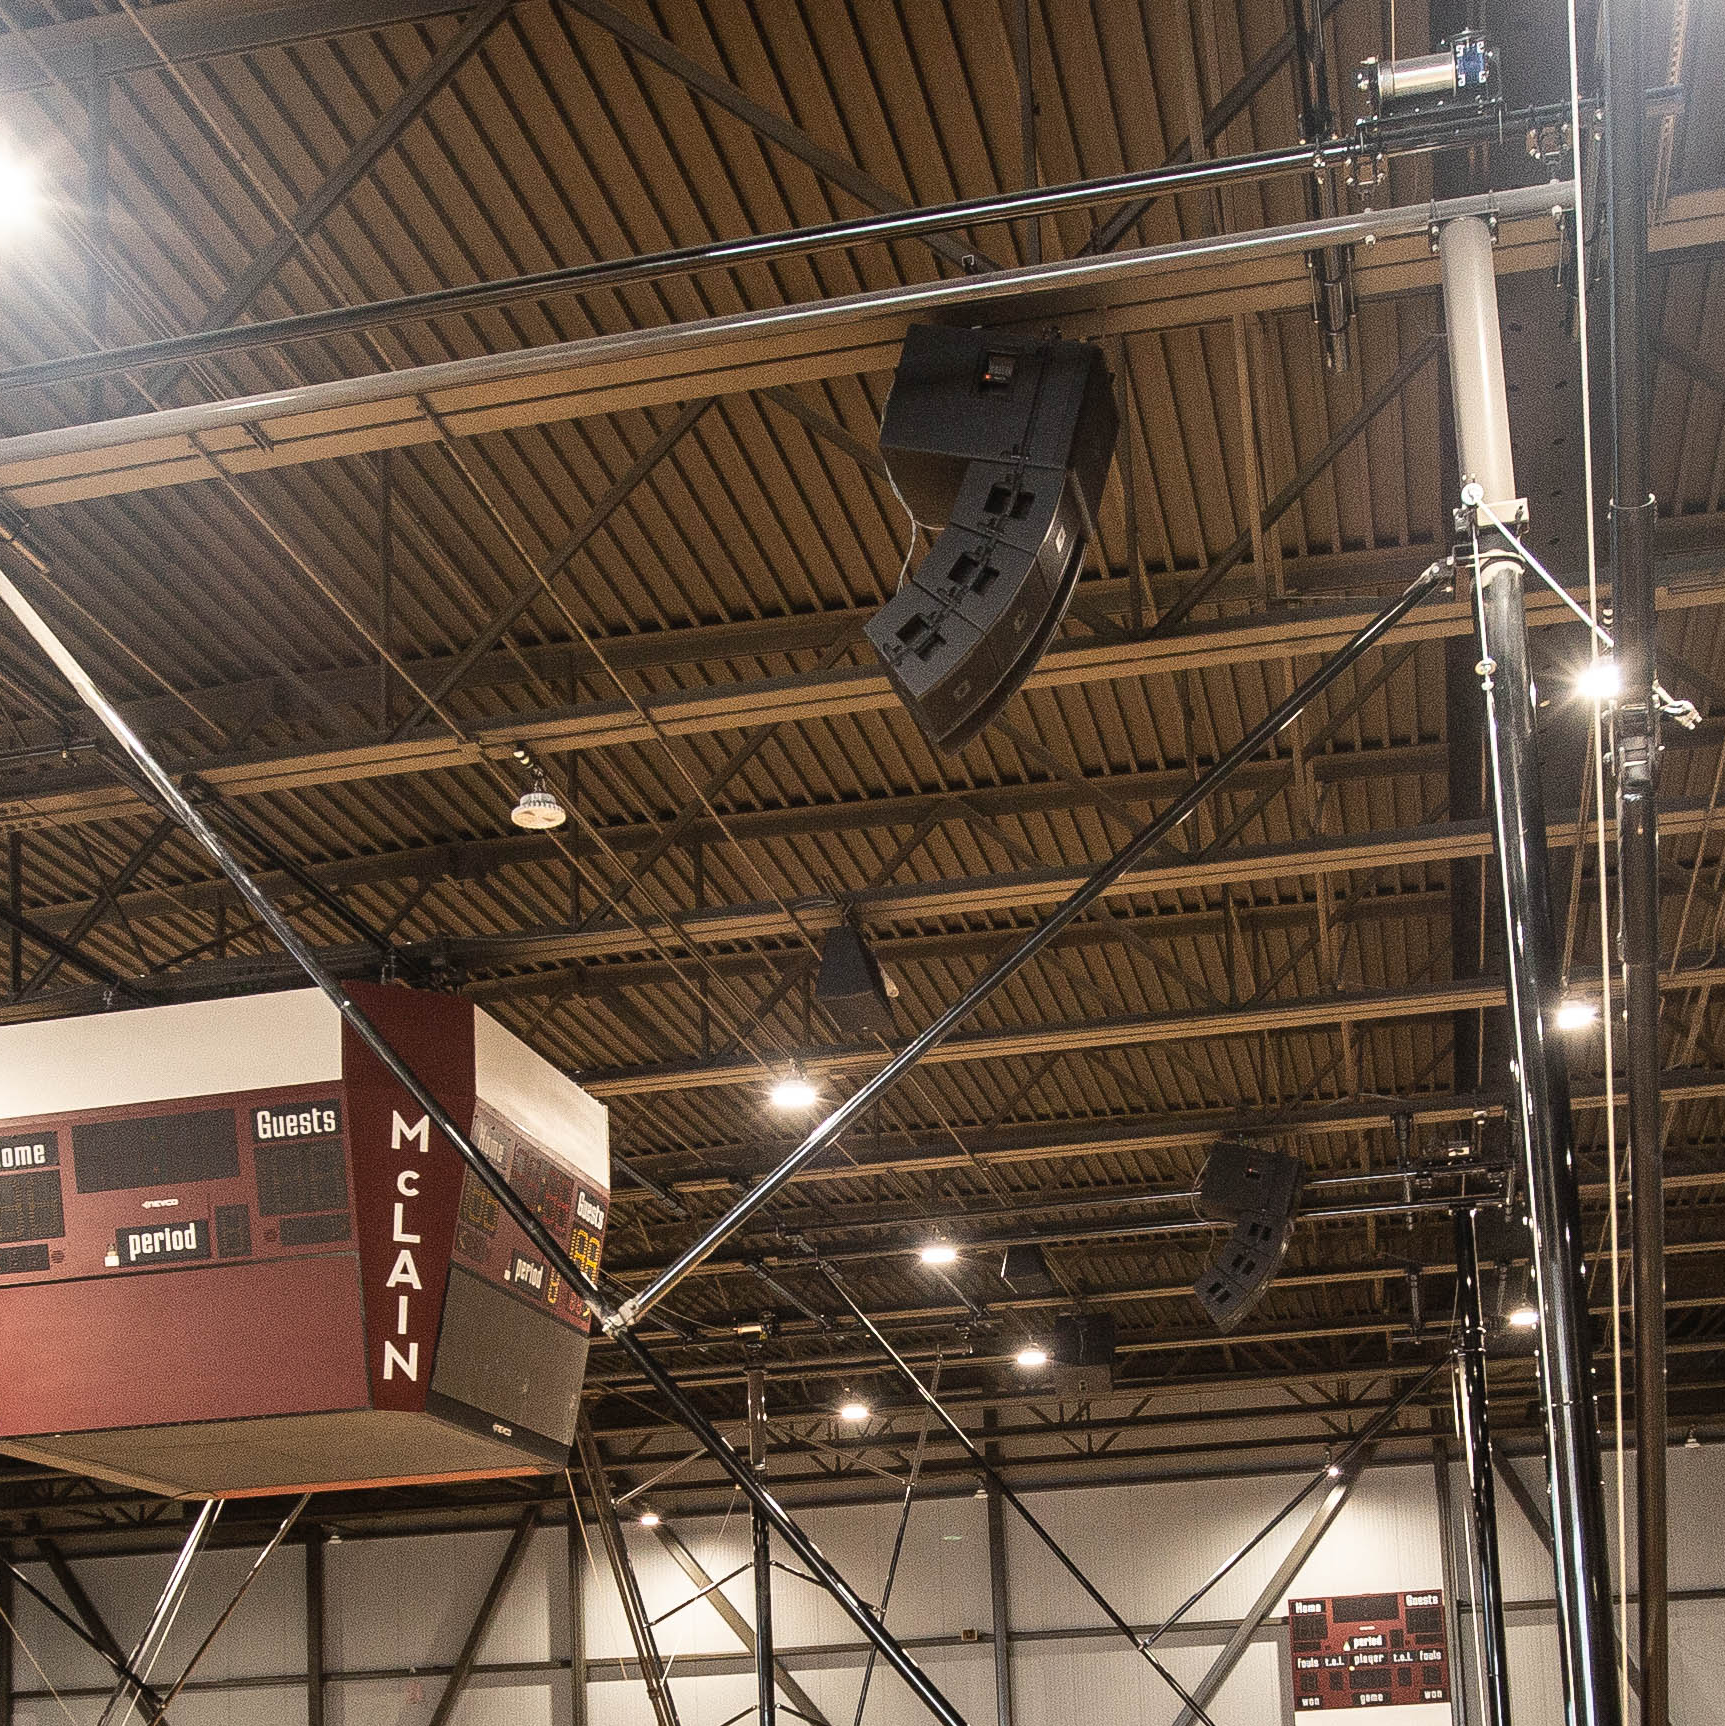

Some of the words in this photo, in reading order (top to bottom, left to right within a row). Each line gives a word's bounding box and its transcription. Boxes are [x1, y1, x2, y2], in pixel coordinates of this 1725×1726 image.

[256, 1108, 337, 1139] Guests
[576, 1190, 605, 1231] Guests
[128, 1222, 197, 1260] period
[383, 1110, 429, 1382] McLAIN
[514, 1258, 544, 1290] period
[1405, 1595, 1439, 1606] Guests
[1295, 1602, 1322, 1613] Home
[1353, 1635, 1383, 1649] period
[1354, 1653, 1384, 1666] player
[1420, 1650, 1442, 1661] fouls
[1297, 1657, 1319, 1669] fouls
[1360, 1693, 1384, 1705] game
